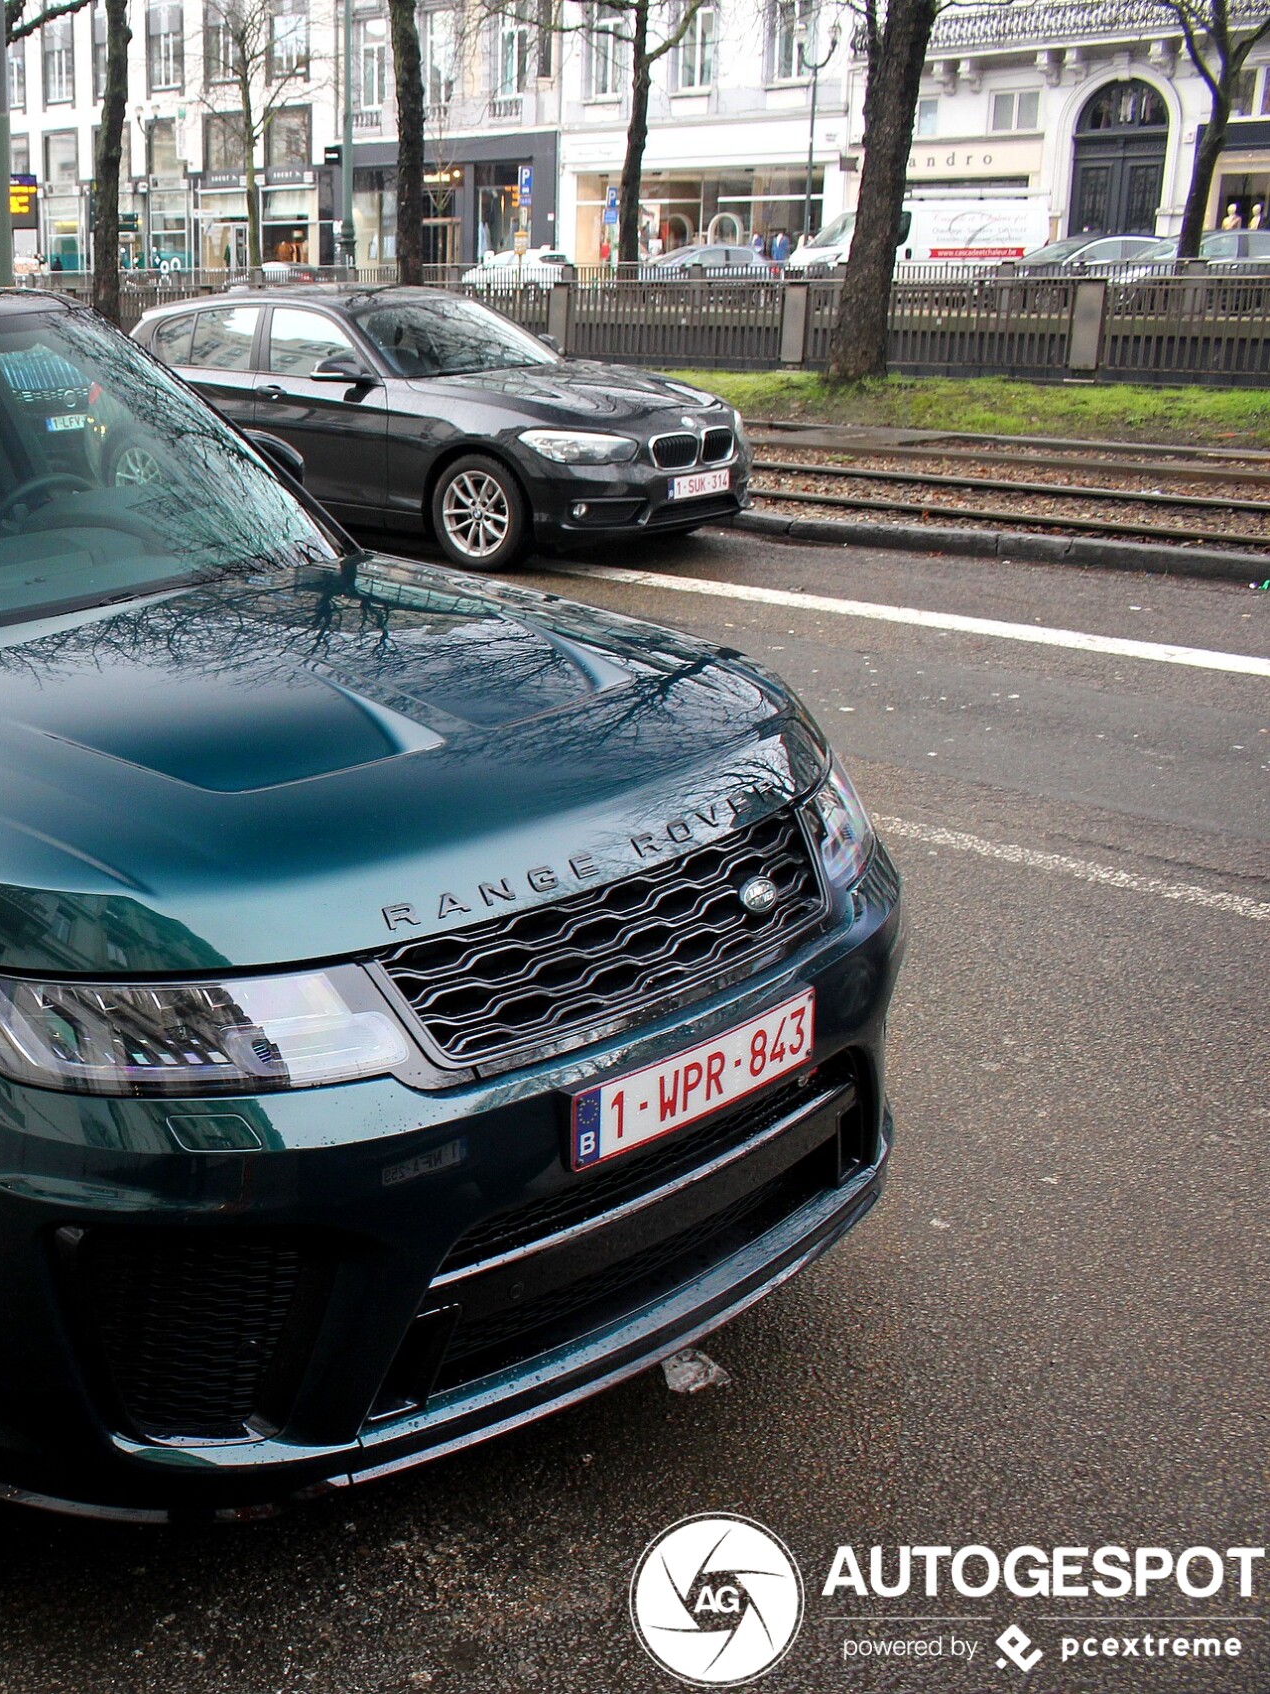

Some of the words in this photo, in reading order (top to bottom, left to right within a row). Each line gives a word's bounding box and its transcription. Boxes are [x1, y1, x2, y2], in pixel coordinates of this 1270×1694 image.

[908, 151, 993, 168] andro
[521, 168, 530, 185] P
[608, 189, 616, 205] P
[676, 472, 728, 496] 1-SUK-314
[381, 852, 600, 931] RANGE
[629, 780, 777, 860] ROVER
[610, 1006, 807, 1139] 1-WPR-843
[579, 1130, 596, 1156] B
